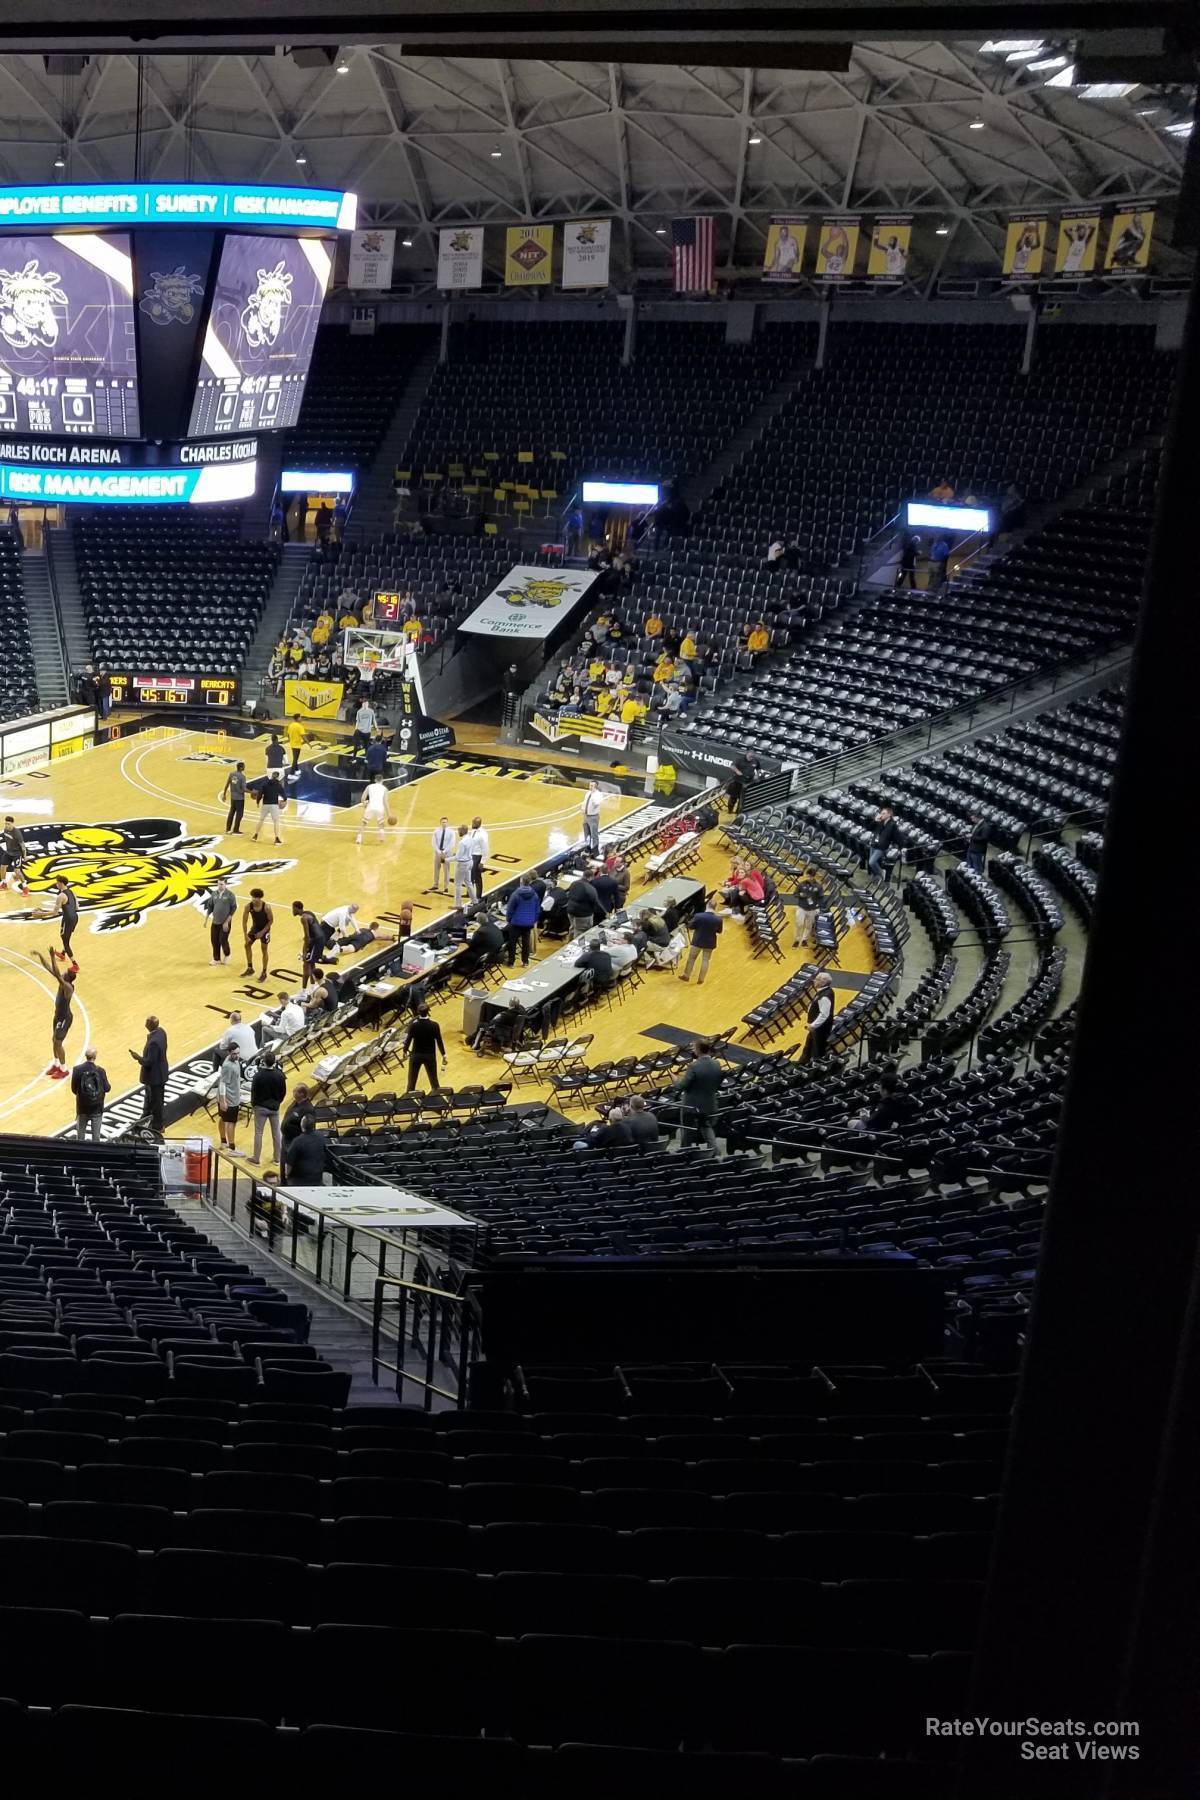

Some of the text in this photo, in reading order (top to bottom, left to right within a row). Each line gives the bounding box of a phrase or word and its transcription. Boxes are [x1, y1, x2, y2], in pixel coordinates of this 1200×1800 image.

[62, 195, 138, 214] BENEFITS
[155, 194, 218, 213] SURETY
[519, 229, 541, 240] 2011
[352, 308, 376, 321] 115
[73, 397, 84, 417] 0
[31, 445, 67, 463] KOCH
[69, 447, 122, 464] ARENA
[180, 445, 232, 463] CHARLES
[8, 471, 42, 494] RISK
[44, 474, 188, 497] MANAGEMENT
[385, 604, 395, 618] 2
[480, 618, 544, 629] Commerce
[491, 625, 522, 634] Bank
[200, 679, 236, 690] BEARCATS
[112, 687, 122, 700] 0
[218, 690, 228, 703] 0
[402, 683, 412, 714] WSU
[425, 757, 570, 785] STATE
